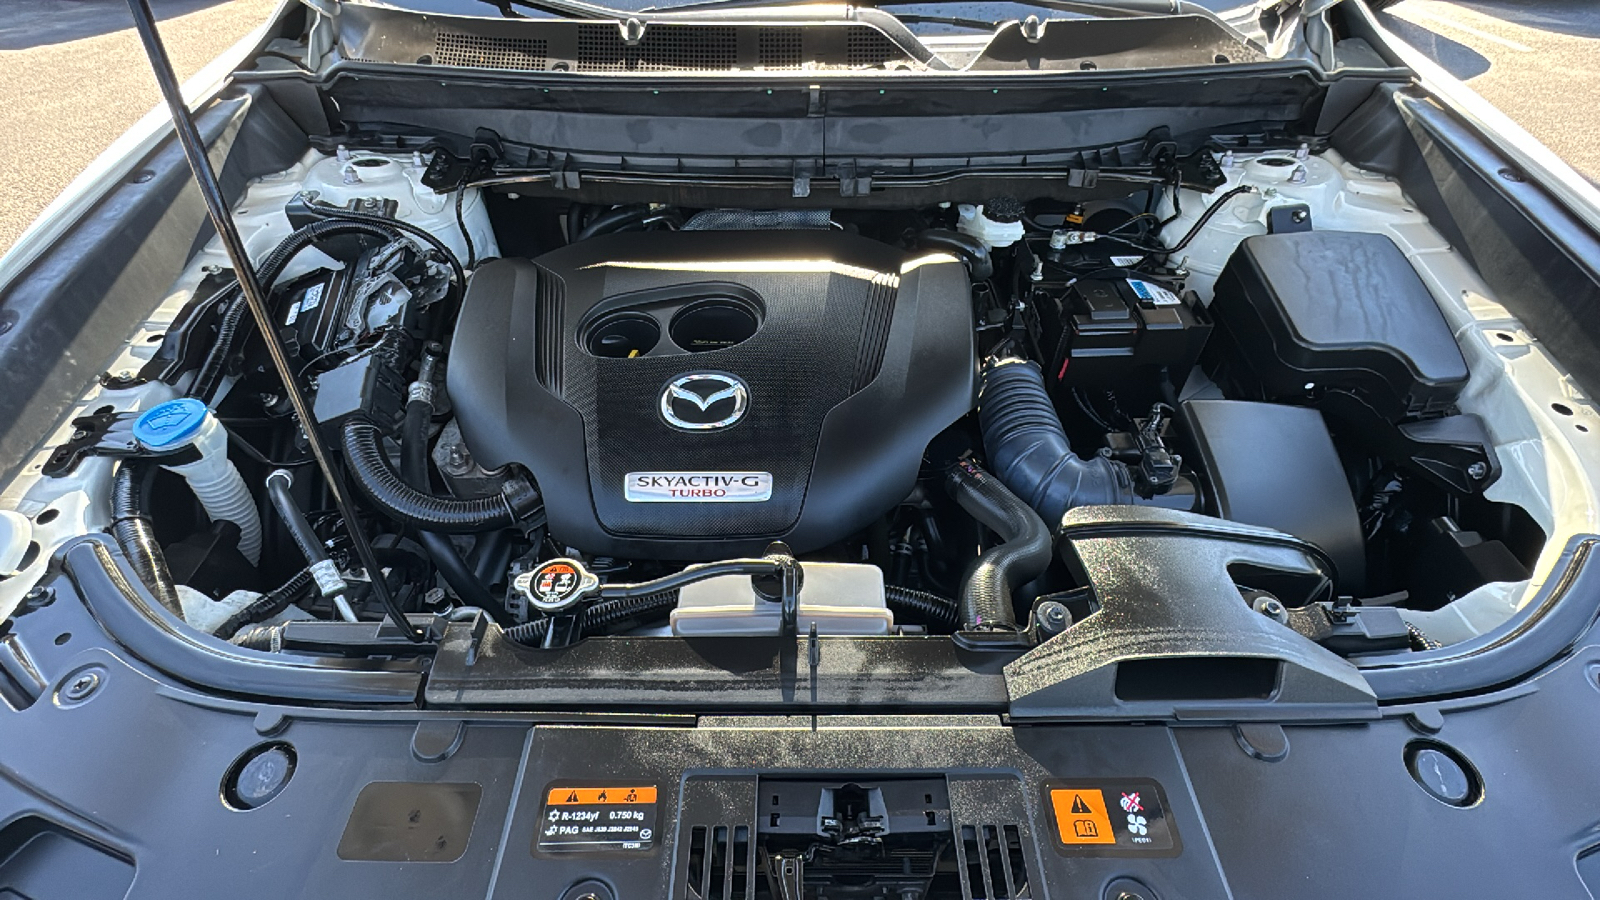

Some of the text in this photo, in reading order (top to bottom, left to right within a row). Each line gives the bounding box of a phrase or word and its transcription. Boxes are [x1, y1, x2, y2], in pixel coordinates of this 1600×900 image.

[636, 476, 759, 487] SKYACTIV-G
[668, 489, 726, 497] TURBO
[561, 811, 645, 822] R-1234yf 0.750 kg
[559, 825, 579, 835] PAG
